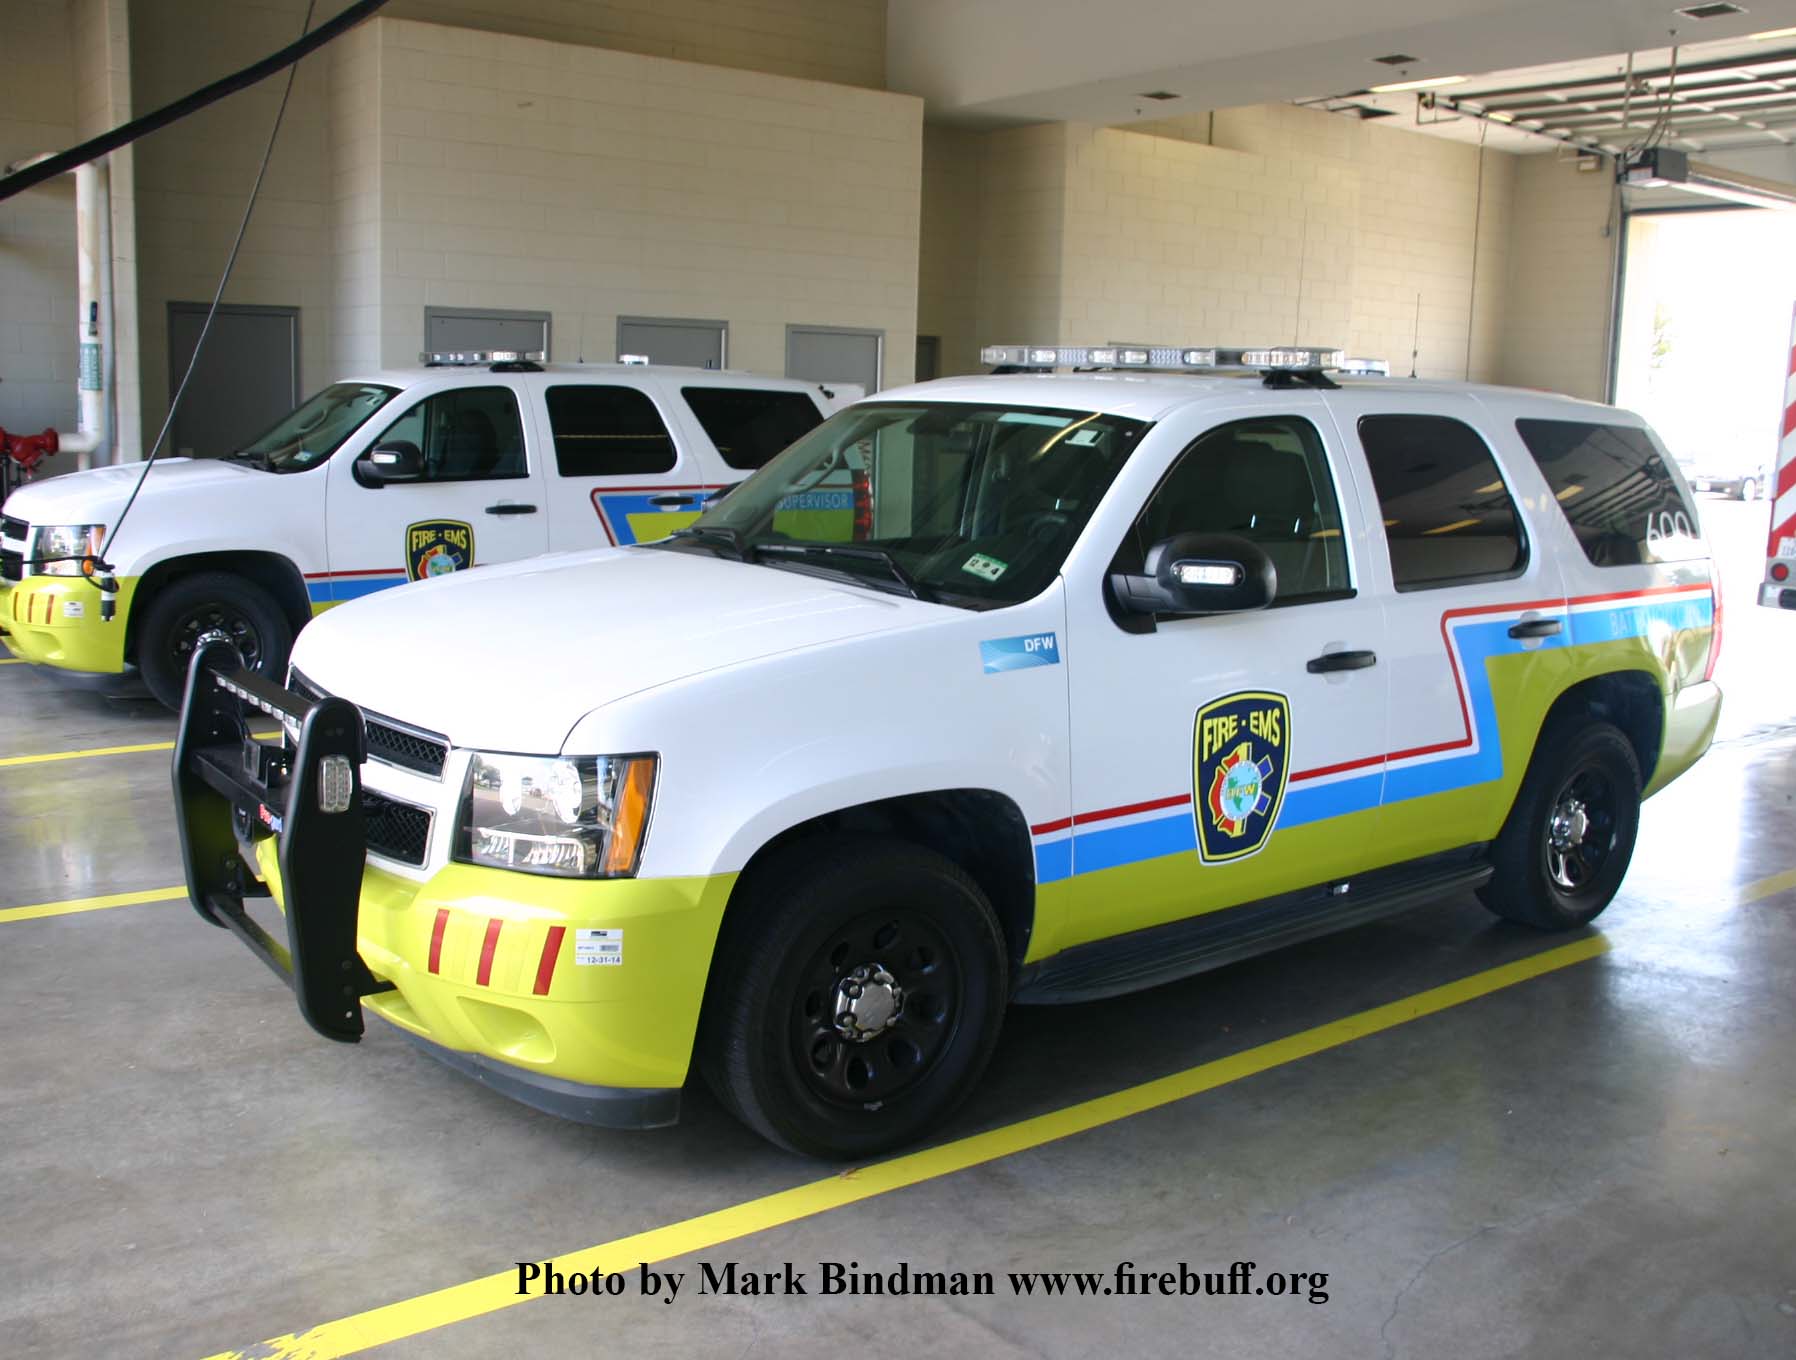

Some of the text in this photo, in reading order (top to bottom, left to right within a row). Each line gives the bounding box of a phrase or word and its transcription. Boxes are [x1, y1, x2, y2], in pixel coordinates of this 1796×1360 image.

[777, 493, 849, 509] SUPERVISOR
[1647, 511, 1691, 549] 600
[412, 529, 466, 552] FIRE EMS
[1024, 636, 1054, 652] DFW
[1203, 708, 1280, 762] FIRE EMS
[587, 956, 621, 964] 12-31-14
